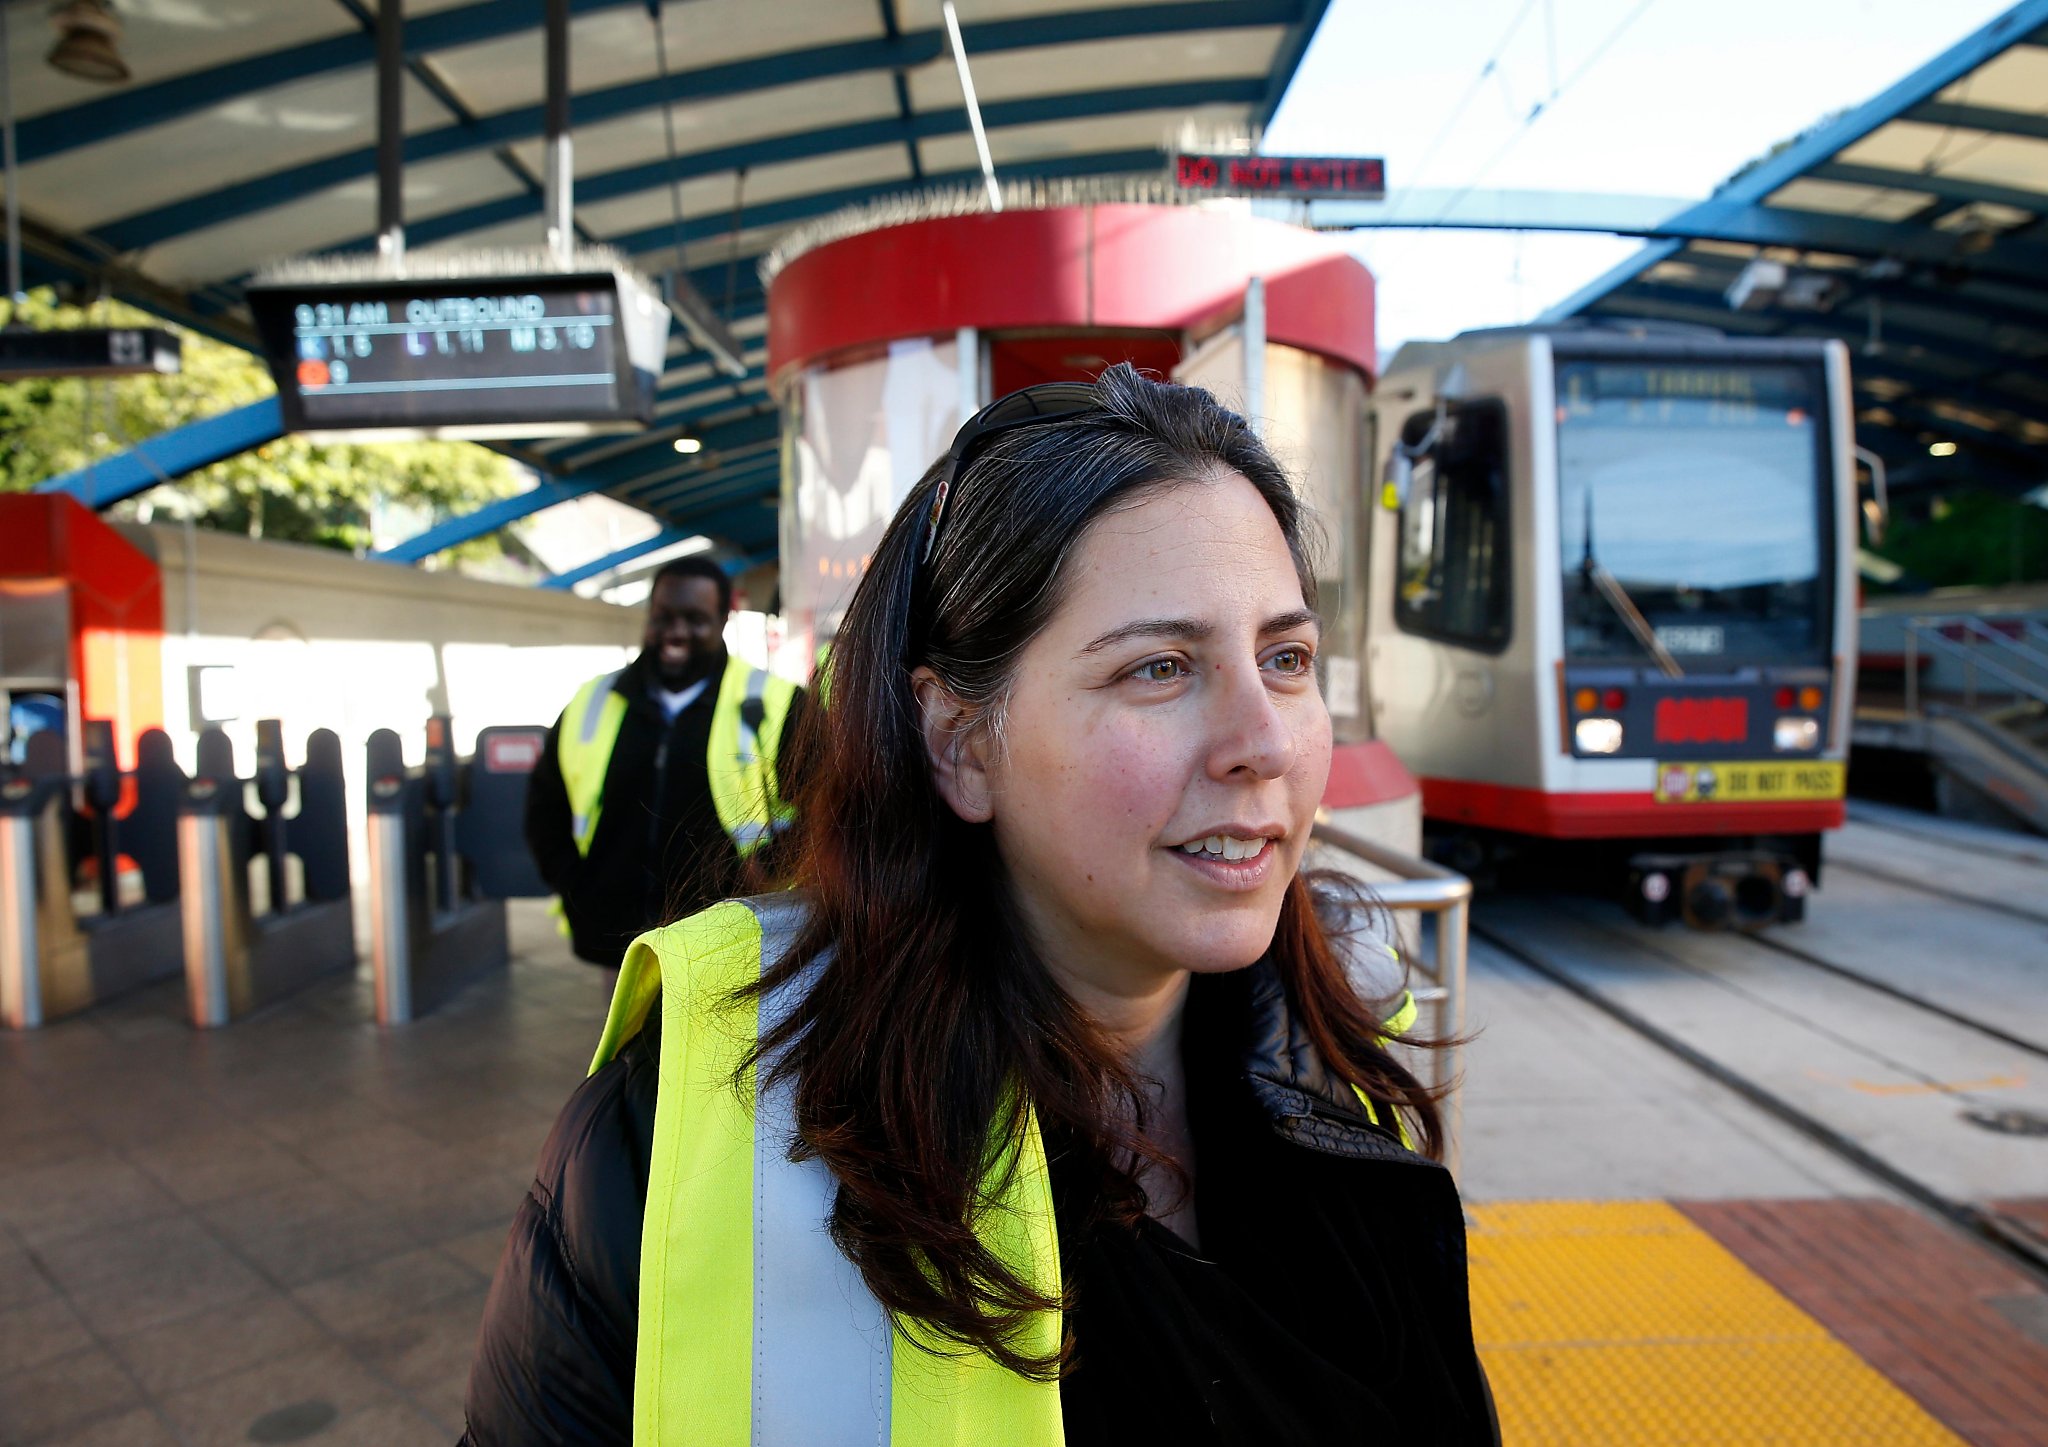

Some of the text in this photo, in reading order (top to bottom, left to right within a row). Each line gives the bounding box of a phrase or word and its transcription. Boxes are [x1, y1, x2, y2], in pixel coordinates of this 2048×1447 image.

[1177, 155, 1219, 189] DO
[1229, 157, 1281, 190] NOT
[347, 301, 388, 325] AM
[406, 295, 545, 326] OUTBOUND
[1758, 771, 1784, 792] NOT
[1796, 769, 1833, 791] PASS
